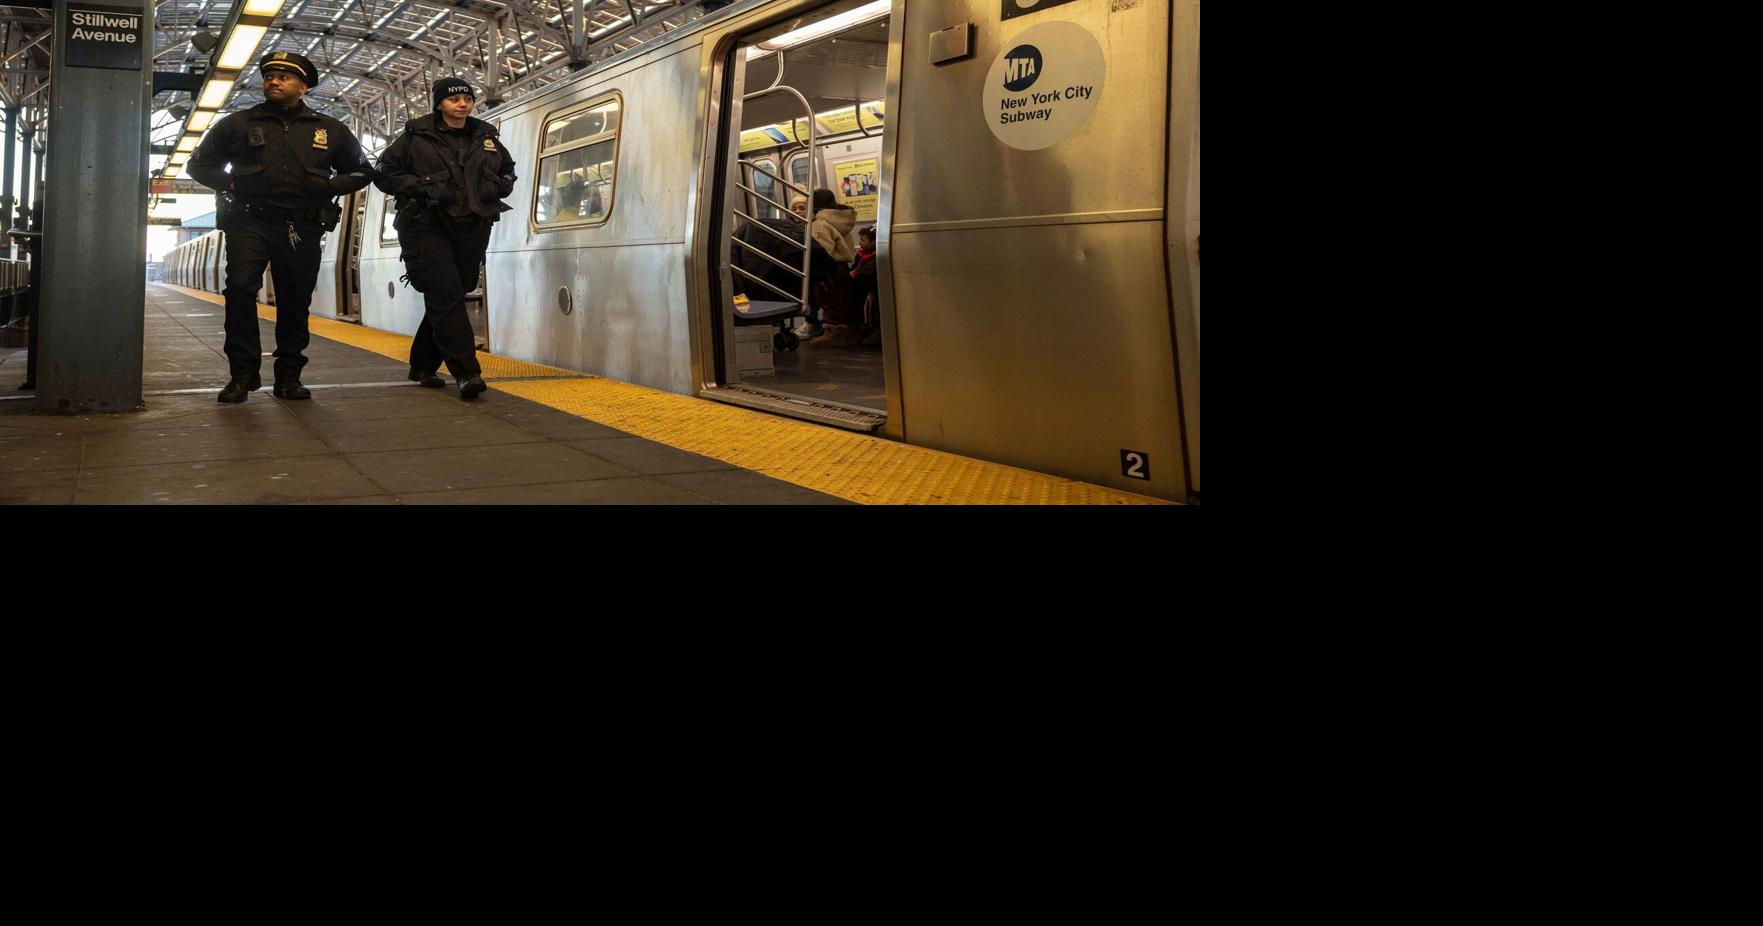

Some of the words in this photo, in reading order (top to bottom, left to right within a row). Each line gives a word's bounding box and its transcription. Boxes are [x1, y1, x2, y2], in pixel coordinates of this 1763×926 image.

[72, 12, 138, 29] Stillwell
[71, 27, 137, 43] Avenue
[1003, 58, 1036, 84] MTA
[1001, 97, 1027, 110] New
[1031, 90, 1061, 105] York
[1065, 85, 1093, 100] City
[1000, 108, 1052, 124] Subway
[1126, 452, 1145, 478] 2
